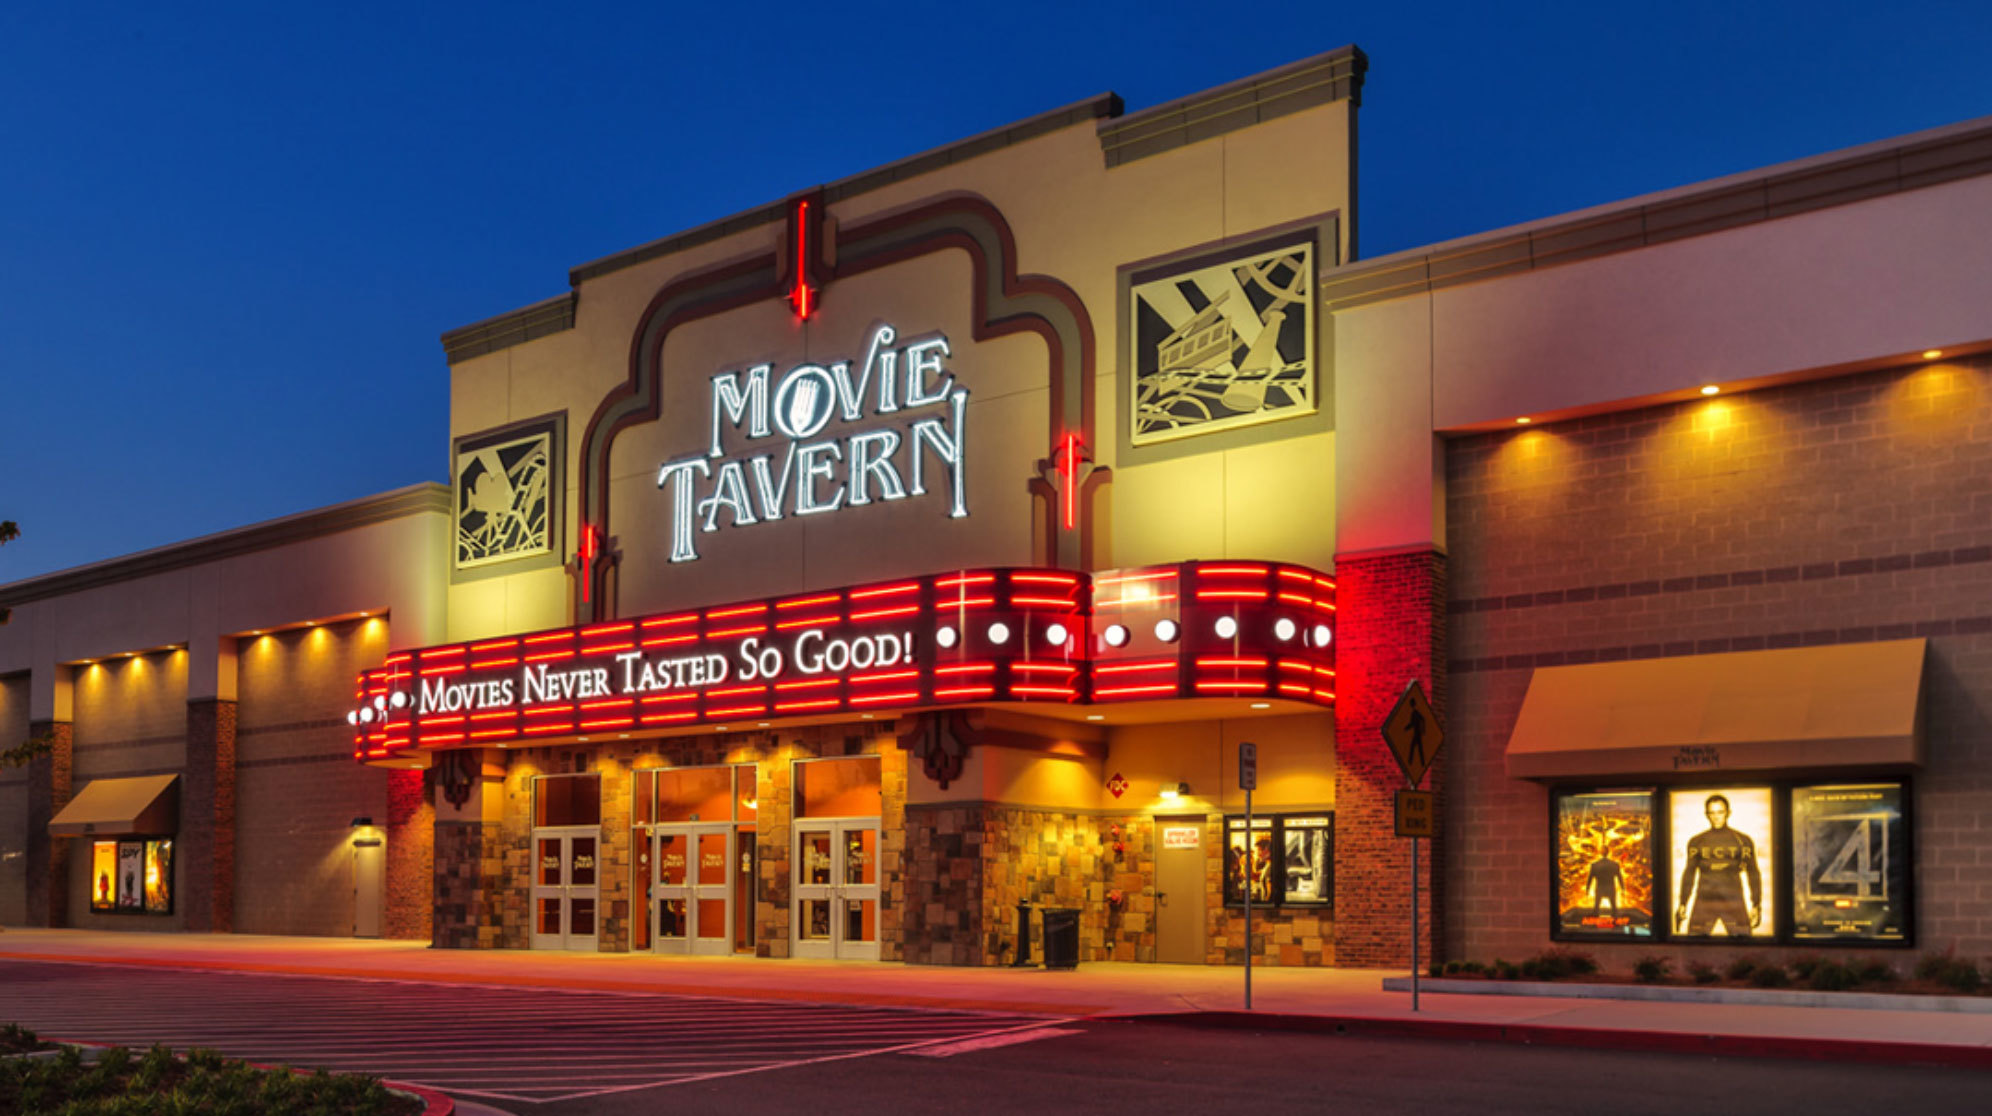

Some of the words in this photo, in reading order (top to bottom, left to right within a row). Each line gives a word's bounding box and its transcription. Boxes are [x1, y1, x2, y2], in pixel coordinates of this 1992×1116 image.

[709, 325, 954, 459] MOVIE
[656, 390, 968, 563] TAVERN
[418, 676, 514, 715] MOVIES
[521, 663, 611, 705] NEVER
[615, 650, 728, 693] TASTED
[738, 637, 783, 680] SO
[794, 629, 912, 675] GOOD!
[1680, 846, 1762, 859] PECTR
